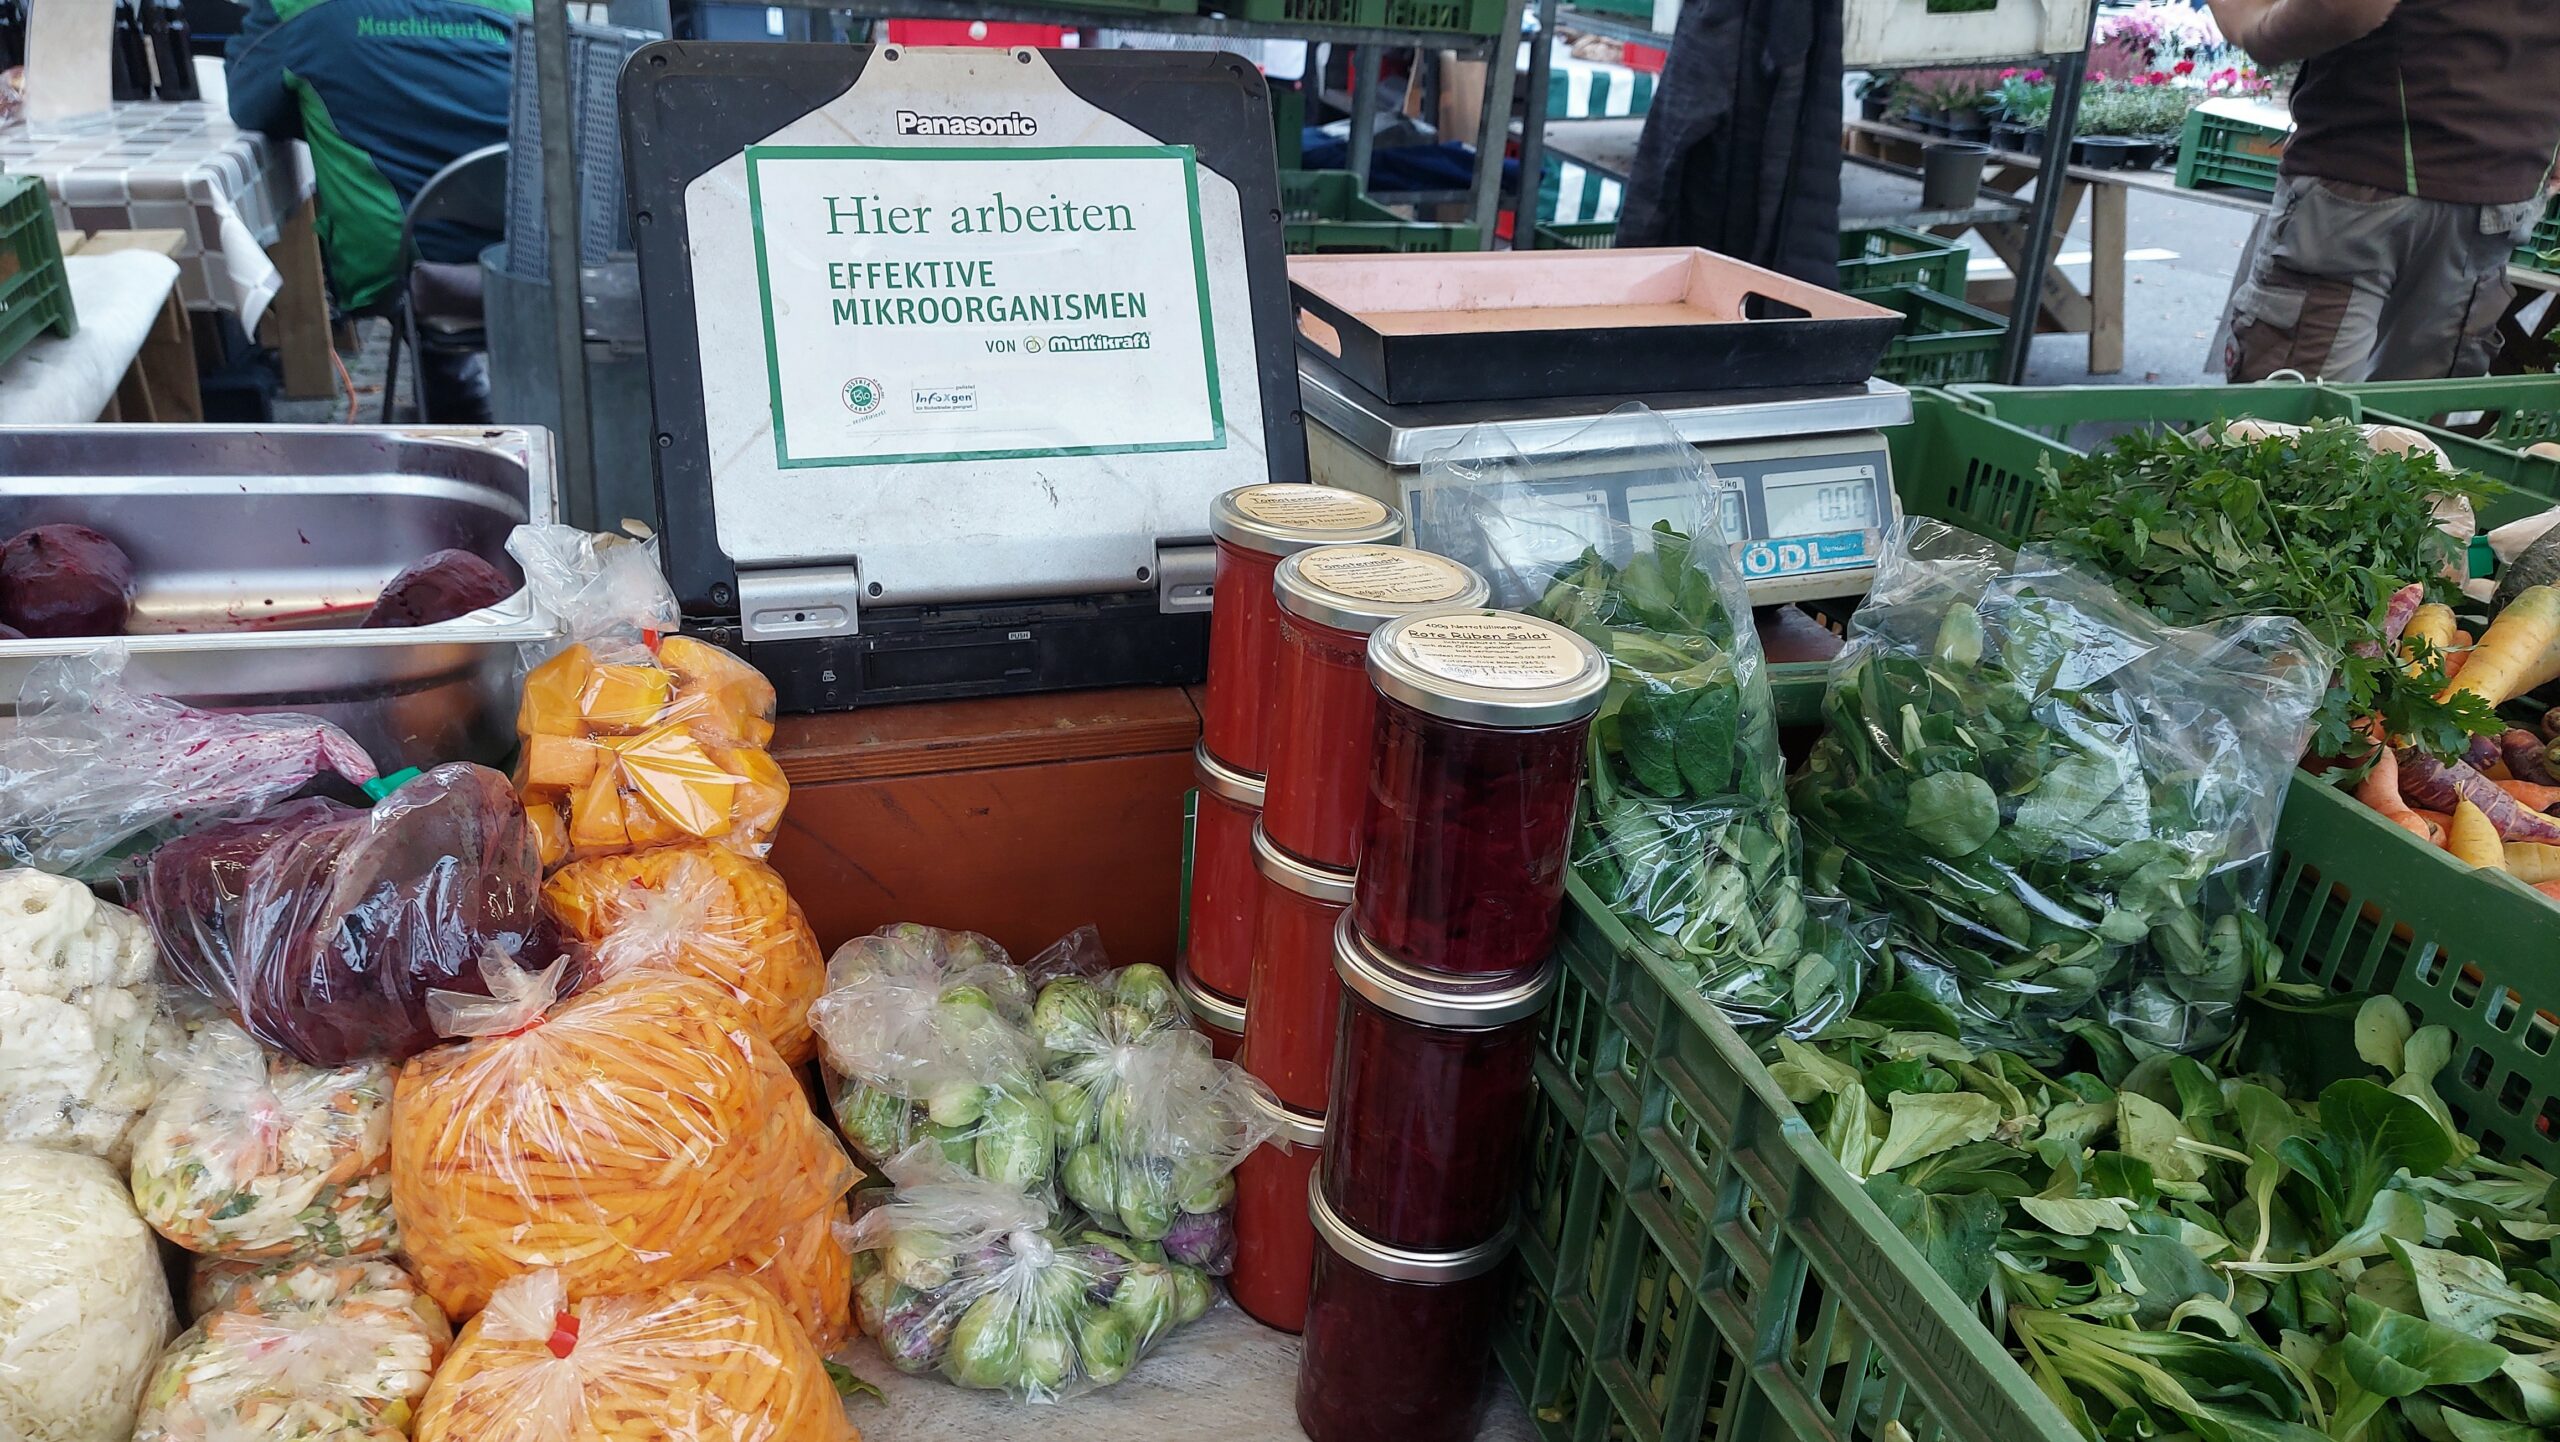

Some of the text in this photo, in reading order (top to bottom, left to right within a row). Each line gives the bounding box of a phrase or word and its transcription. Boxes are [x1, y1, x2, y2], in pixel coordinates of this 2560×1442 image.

[357, 15, 505, 45] Maschinenring
[896, 110, 1037, 135] Panasonic
[822, 192, 1136, 234] Hier arbeiten
[828, 260, 996, 289] EFFEKTIVE
[833, 292, 1147, 325] MIKROORGANISMEN
[985, 340, 1016, 353] VON
[1313, 556, 1405, 570] Tomatenmark
[1408, 630, 1548, 640] Rote Rüben Salat
